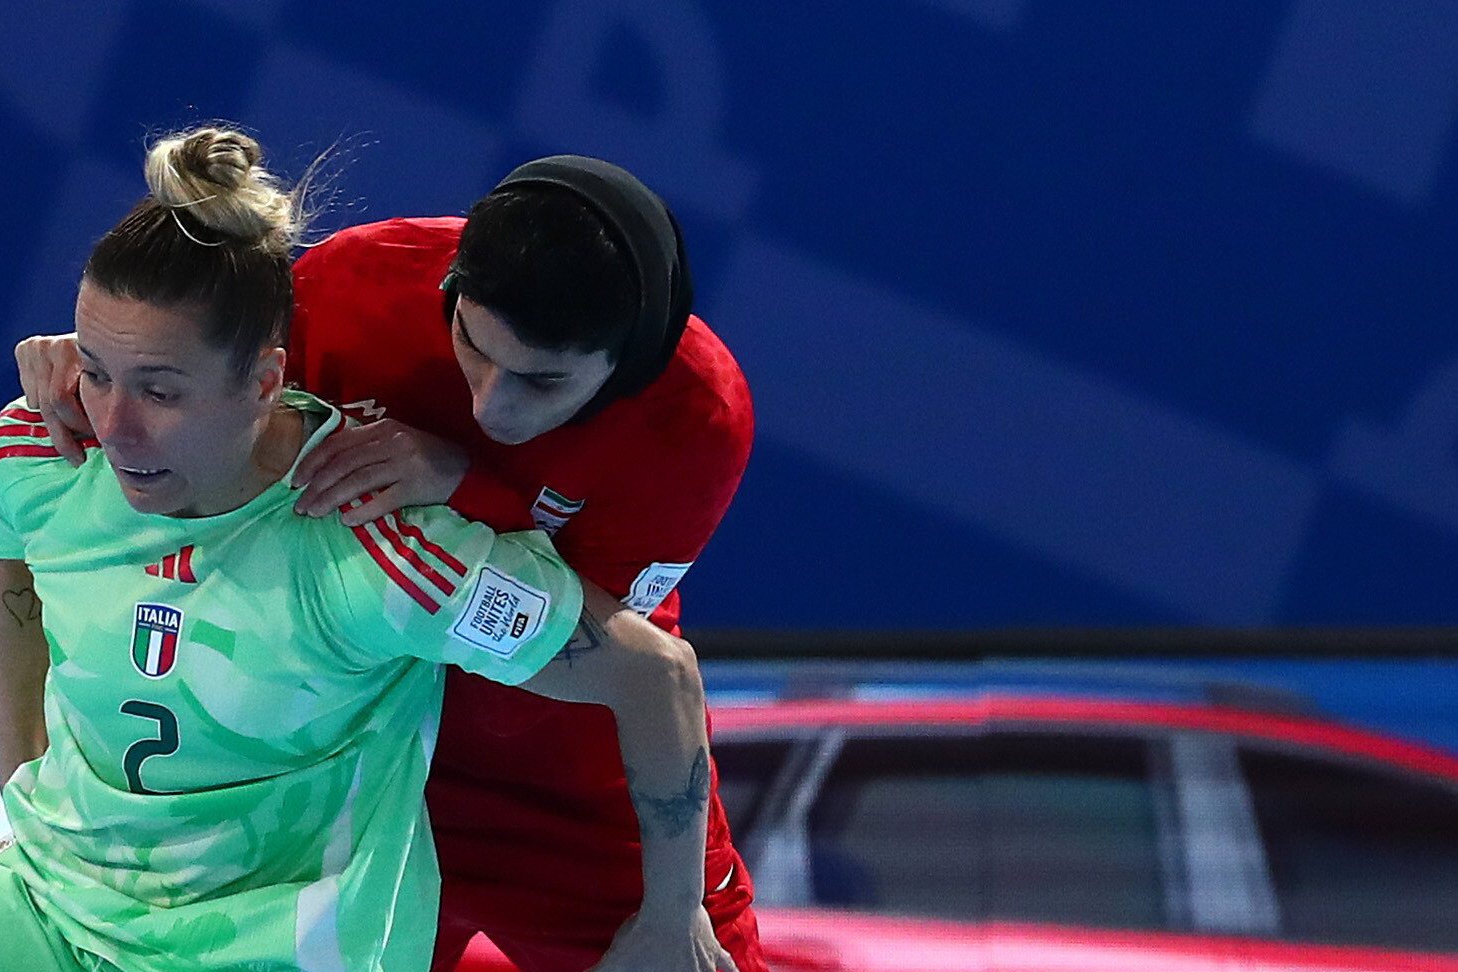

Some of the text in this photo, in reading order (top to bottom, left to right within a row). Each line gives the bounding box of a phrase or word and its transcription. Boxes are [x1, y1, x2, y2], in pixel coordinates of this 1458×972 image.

[138, 606, 178, 628] ITALIA
[470, 586, 497, 629] FOOTBALL
[479, 589, 509, 636] UNITES
[492, 593, 521, 642] the World
[513, 617, 526, 636] FIFA
[119, 699, 184, 796] 2
